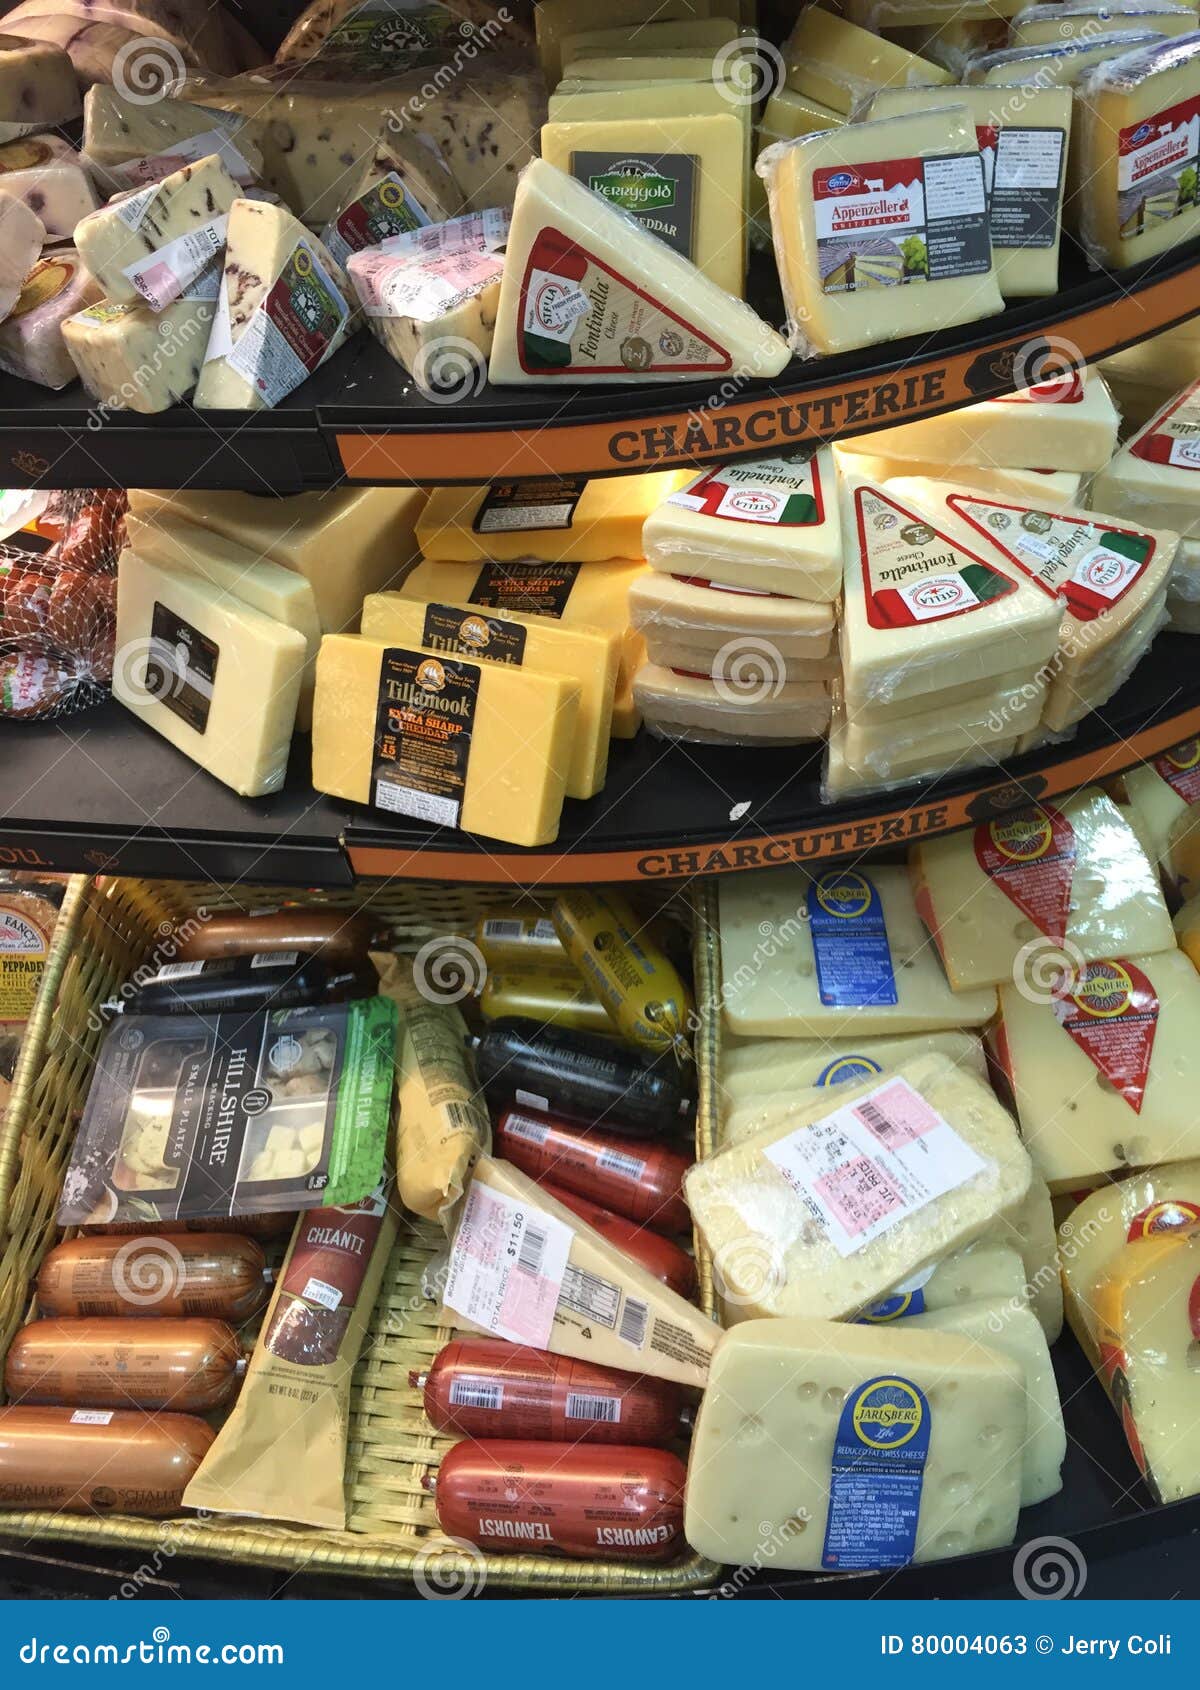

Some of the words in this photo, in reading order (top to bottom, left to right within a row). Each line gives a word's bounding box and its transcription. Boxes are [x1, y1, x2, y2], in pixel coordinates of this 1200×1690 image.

[832, 199, 899, 222] Appenzeller
[637, 217, 678, 237] EDDAR
[579, 280, 609, 360] Fontinella
[608, 368, 947, 463] CHARCUTERIE
[729, 469, 805, 490] Fontinella
[736, 500, 771, 511] STELLA
[879, 553, 957, 582] Fontinella
[896, 550, 924, 563] Cheese
[527, 578, 565, 587] SHARP
[1097, 559, 1119, 588] STELLA
[920, 589, 957, 606] STELLA
[386, 678, 472, 718] Tillamook
[388, 707, 424, 725] EXTRA
[425, 717, 463, 734] SHARP
[399, 721, 450, 740] CHEDDAR
[382, 743, 396, 755] 15
[637, 805, 949, 876] CHARCUTERIE
[995, 821, 1048, 840] JARLSBERG
[4, 915, 39, 942] FANCY
[181, 1064, 200, 1107] SMALL
[360, 1052, 378, 1095] TUSCAN
[204, 1082, 217, 1129] SNACKING
[208, 1047, 247, 1166] HILLSHIRE
[355, 1096, 373, 1129] FLAIR
[172, 1109, 191, 1159] PLATES
[857, 1159, 880, 1188] PRICE
[306, 1226, 366, 1256] CHIANTI
[507, 1212, 524, 1257] $11.50
[268, 1383, 279, 1395] NET
[856, 1409, 918, 1422] JARLSBERG
[837, 1446, 868, 1456] REDUCED
[868, 1448, 880, 1457] FAT
[881, 1450, 901, 1458] SWISS
[901, 1451, 926, 1459] CHEESE
[479, 1518, 554, 1541] TEAWURST
